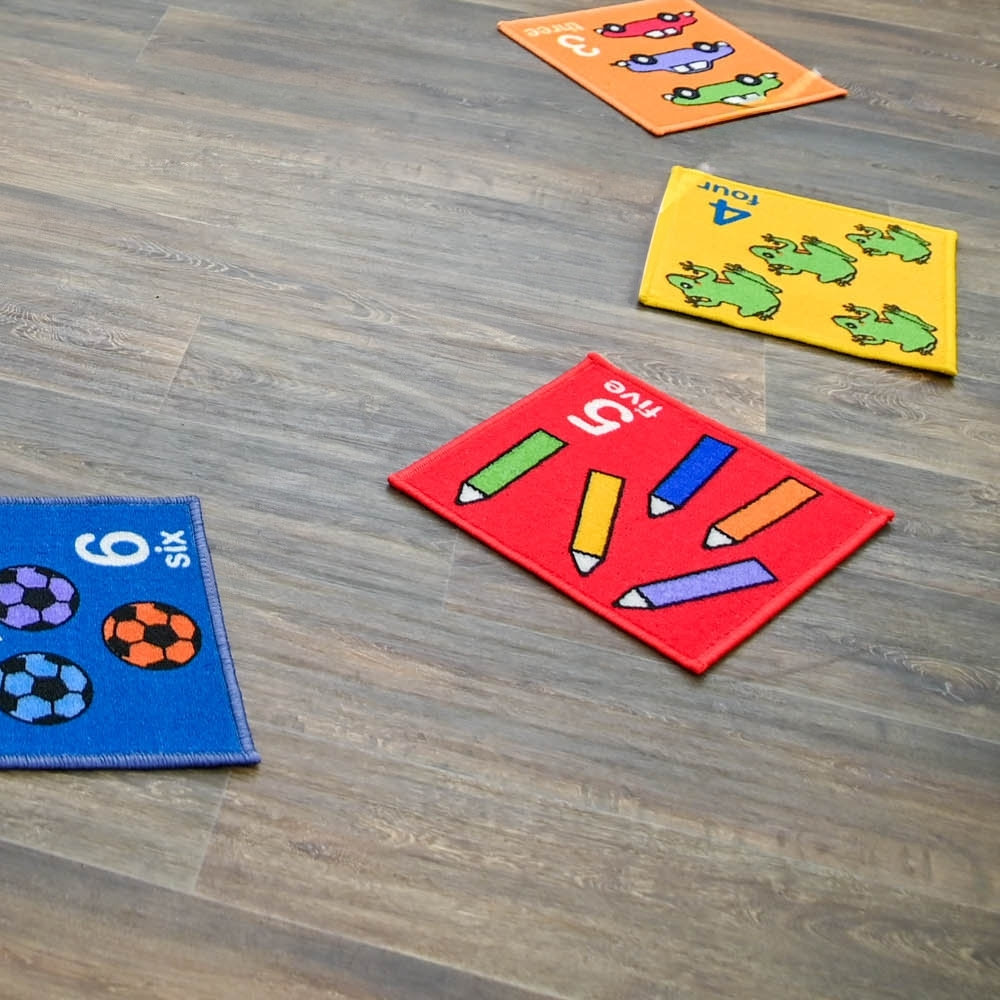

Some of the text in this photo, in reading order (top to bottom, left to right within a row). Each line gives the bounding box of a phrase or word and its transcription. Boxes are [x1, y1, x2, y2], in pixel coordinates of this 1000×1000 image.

[524, 21, 585, 37] three
[557, 34, 601, 57] 3
[696, 181, 760, 206] four
[709, 199, 752, 226] 4
[603, 379, 664, 418] five
[566, 397, 635, 436] 5
[74, 530, 150, 567] 6
[154, 529, 191, 568] six
